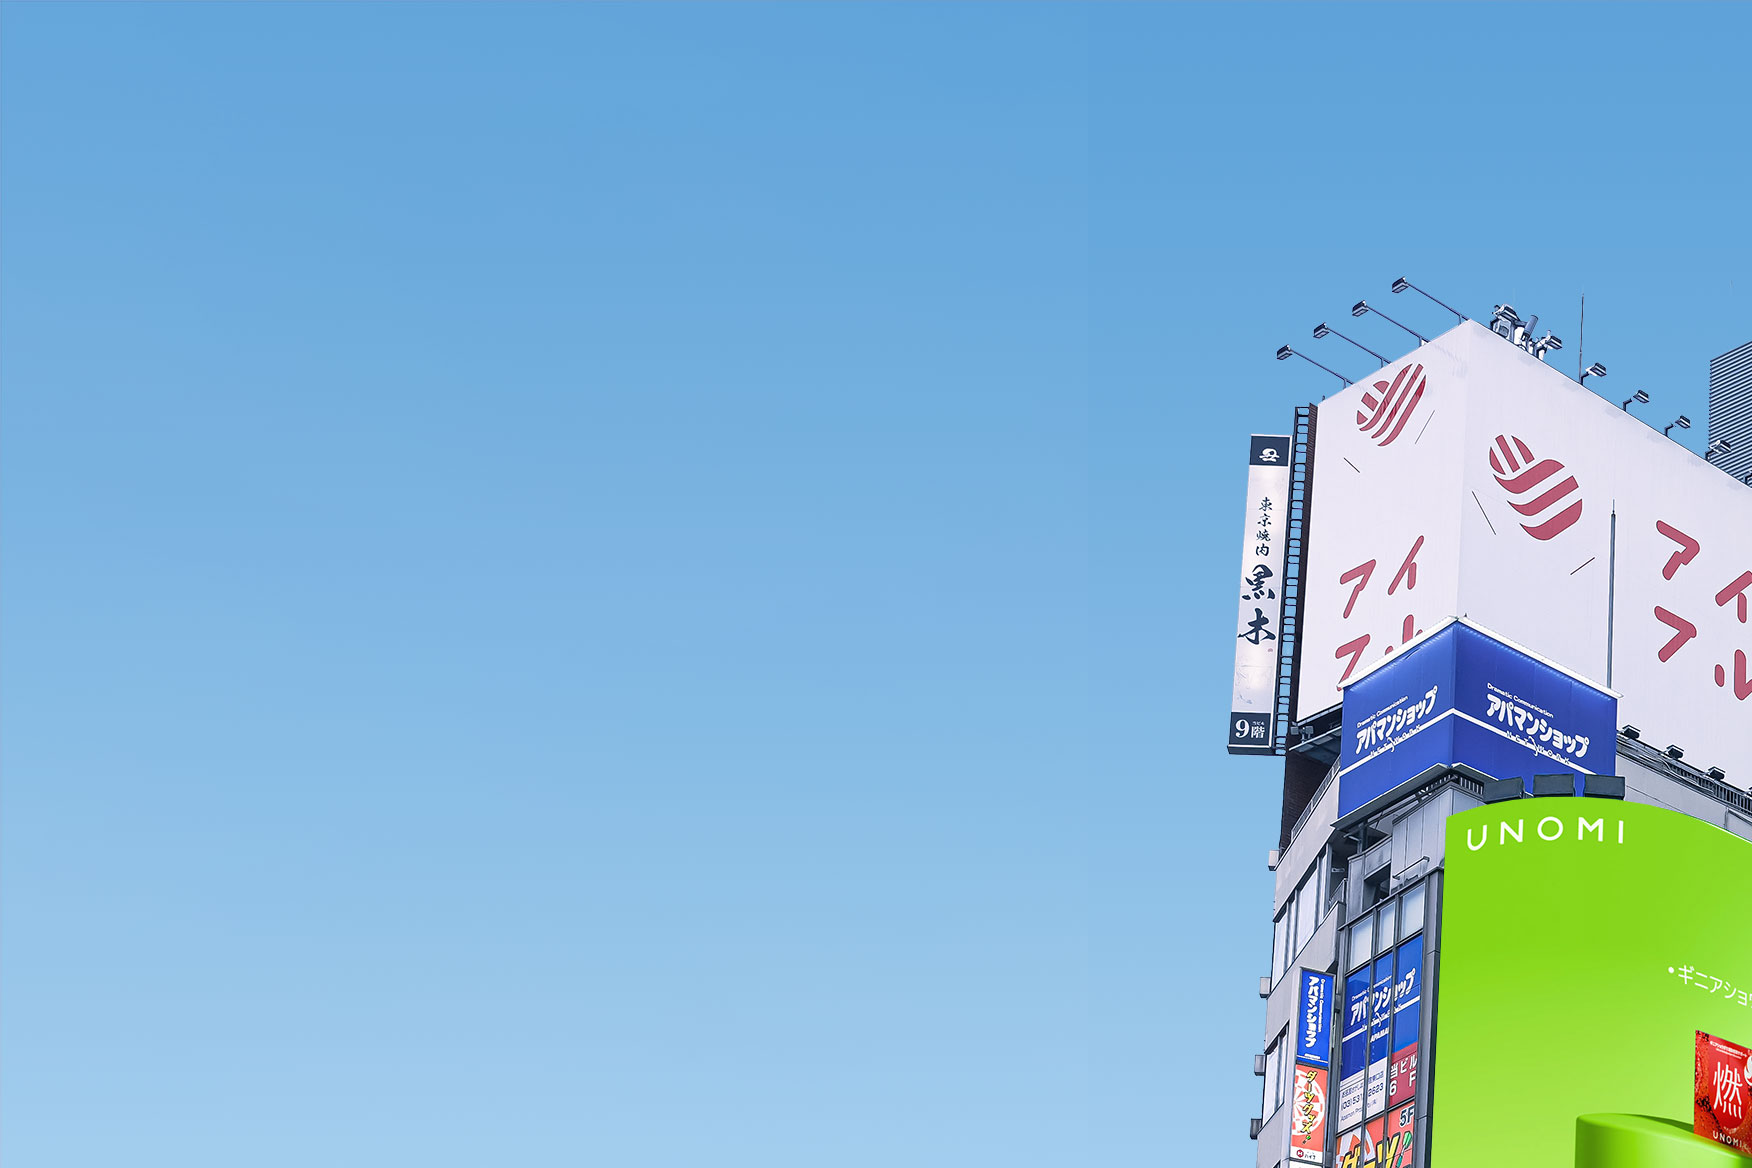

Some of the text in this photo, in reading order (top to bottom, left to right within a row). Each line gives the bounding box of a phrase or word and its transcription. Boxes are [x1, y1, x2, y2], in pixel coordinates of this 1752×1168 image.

[1237, 497, 1276, 645] 東京焼肉 黒木
[1356, 696, 1408, 728] Dramatic Communication
[1487, 682, 1554, 718] Dramatic Communication
[1355, 685, 1438, 755] アパマンショップ
[1486, 693, 1590, 758] アパマンショップ
[1466, 816, 1625, 852] UNOMI
[1350, 968, 1416, 1026] アパンシップ
[1391, 1055, 1417, 1079] 当ビル
[1713, 1061, 1743, 1119] 燃
[1400, 1103, 1415, 1128] 5F
[1712, 1130, 1742, 1147] UNOMI
